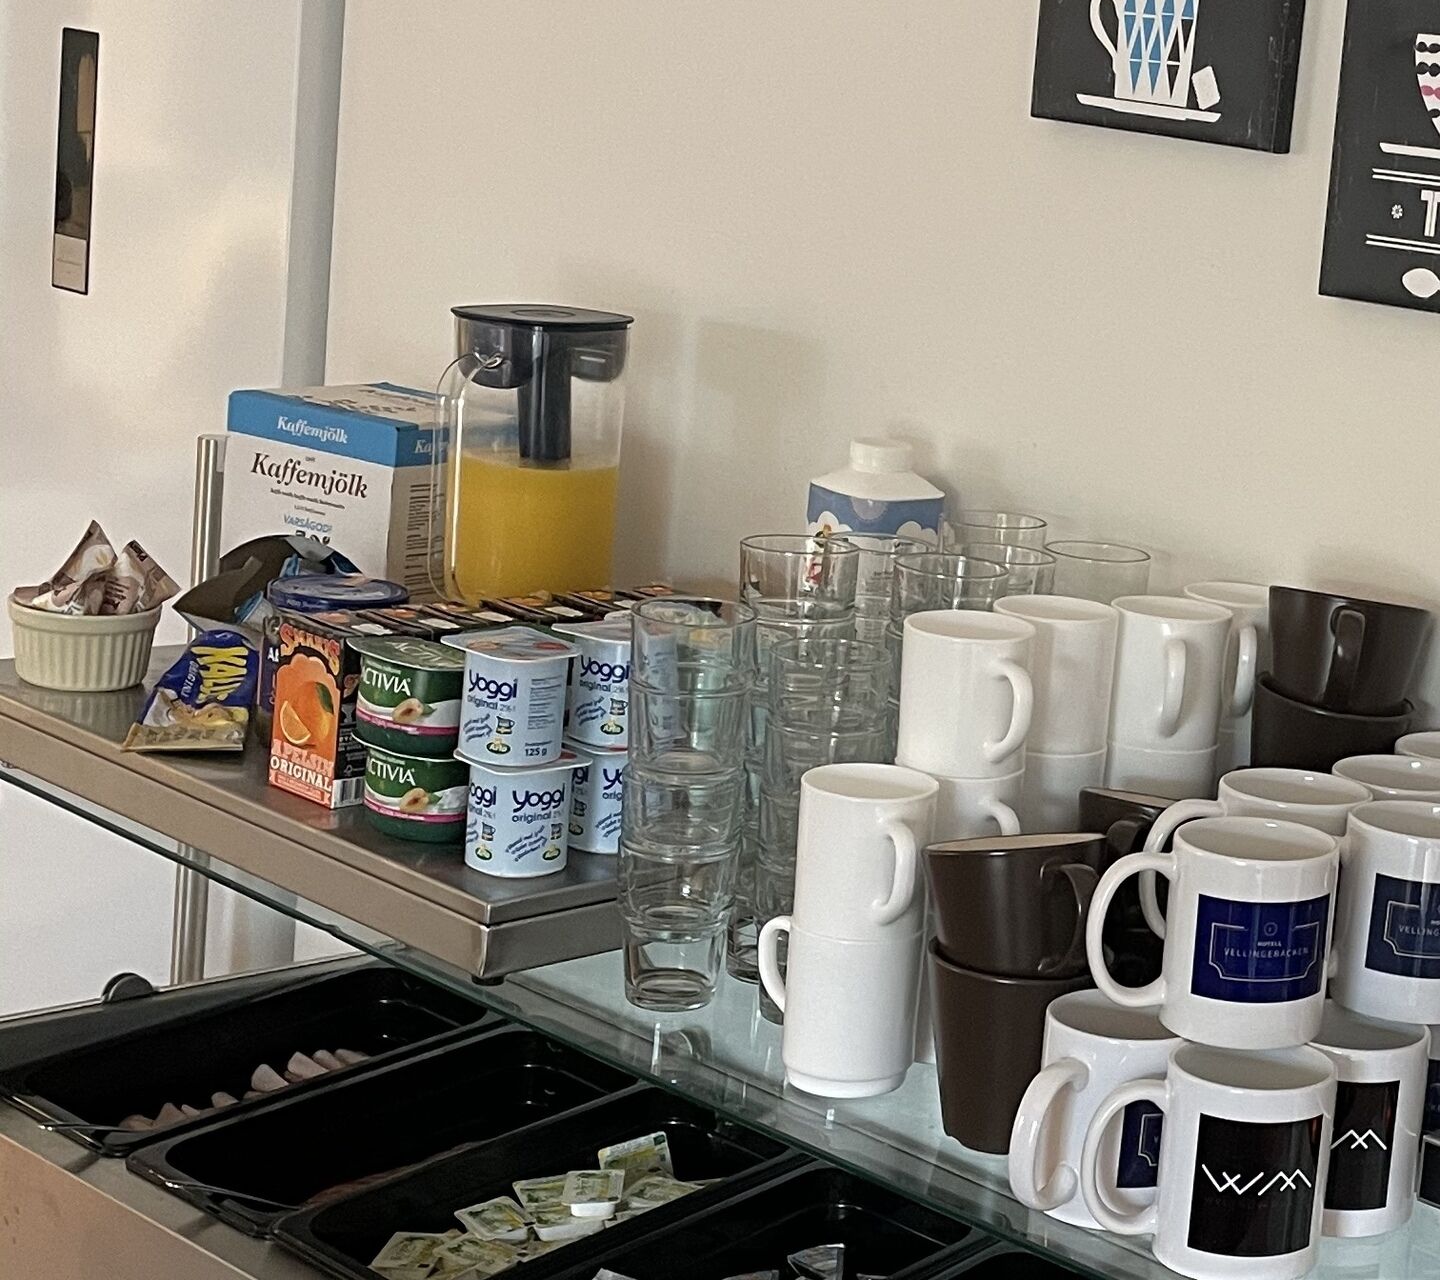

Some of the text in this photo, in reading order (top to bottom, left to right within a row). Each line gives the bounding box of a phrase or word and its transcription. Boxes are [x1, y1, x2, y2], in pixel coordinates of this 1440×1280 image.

[277, 415, 348, 445] Kaffemjölk
[251, 453, 368, 498] Kaffemjölk
[525, 748, 540, 757] 125
[270, 755, 333, 792] ORIGINAL
